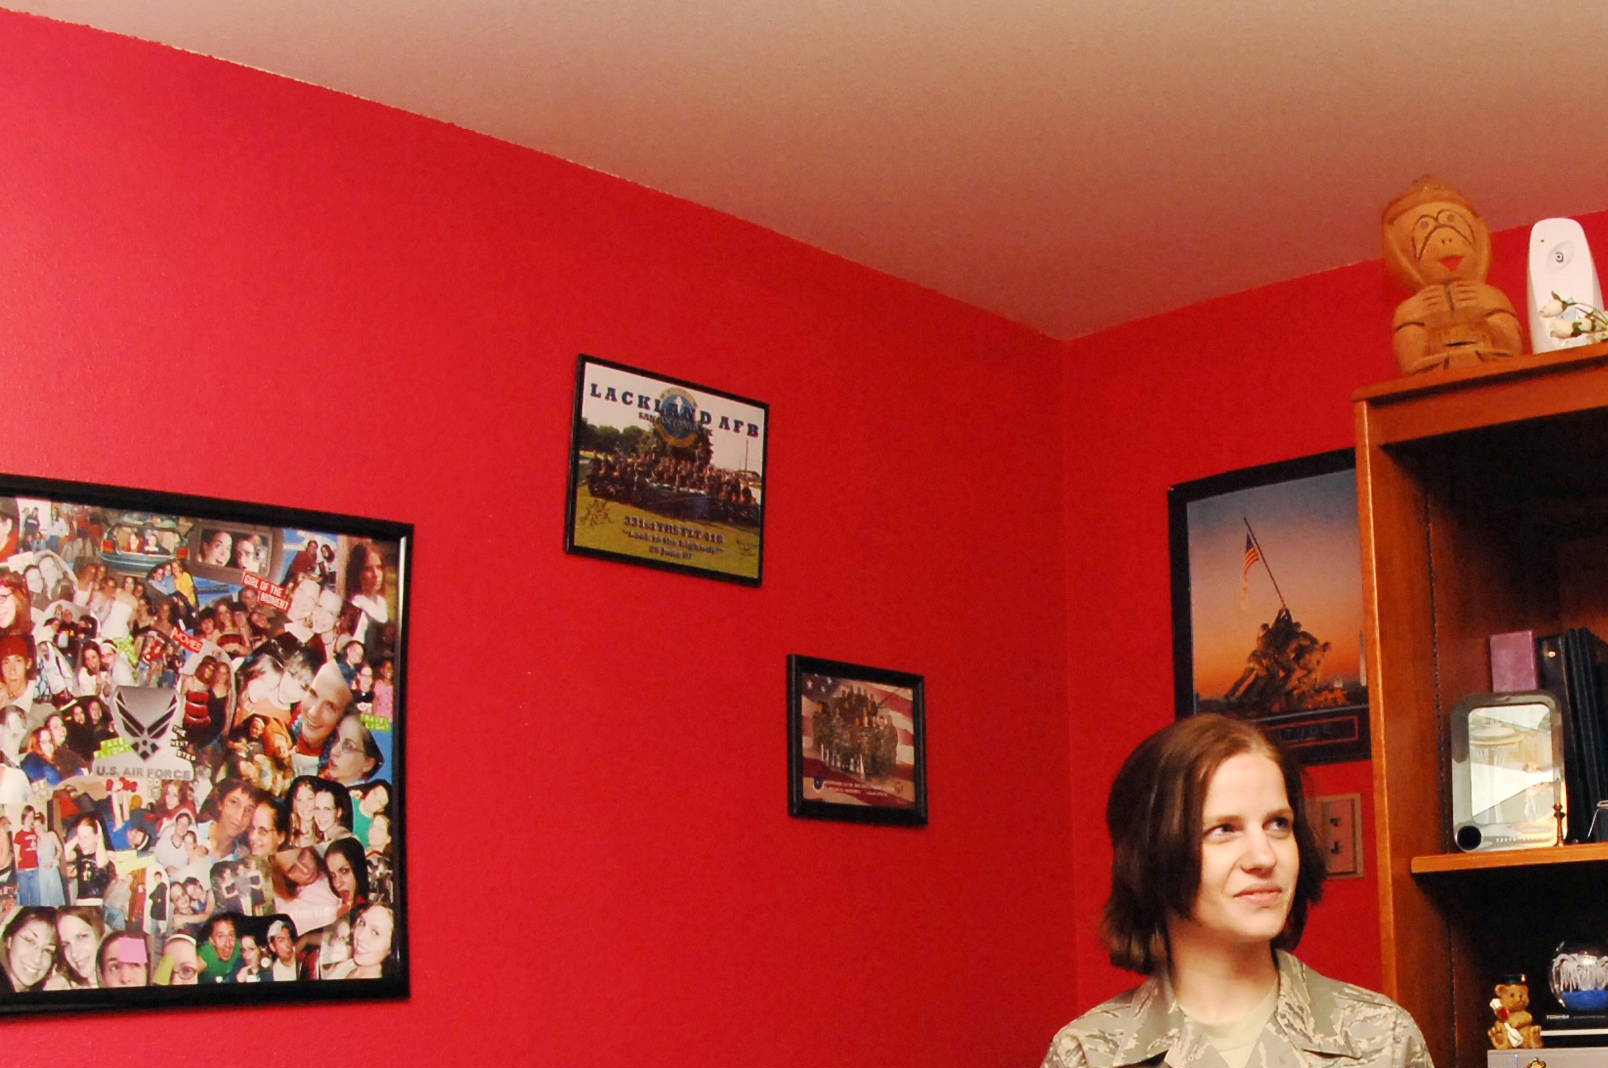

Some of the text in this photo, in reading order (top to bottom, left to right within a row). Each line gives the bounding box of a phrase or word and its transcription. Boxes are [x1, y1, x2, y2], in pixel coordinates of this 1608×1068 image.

[719, 415, 760, 438] AFB
[123, 767, 144, 778] AIR
[147, 768, 191, 780] FORCE
